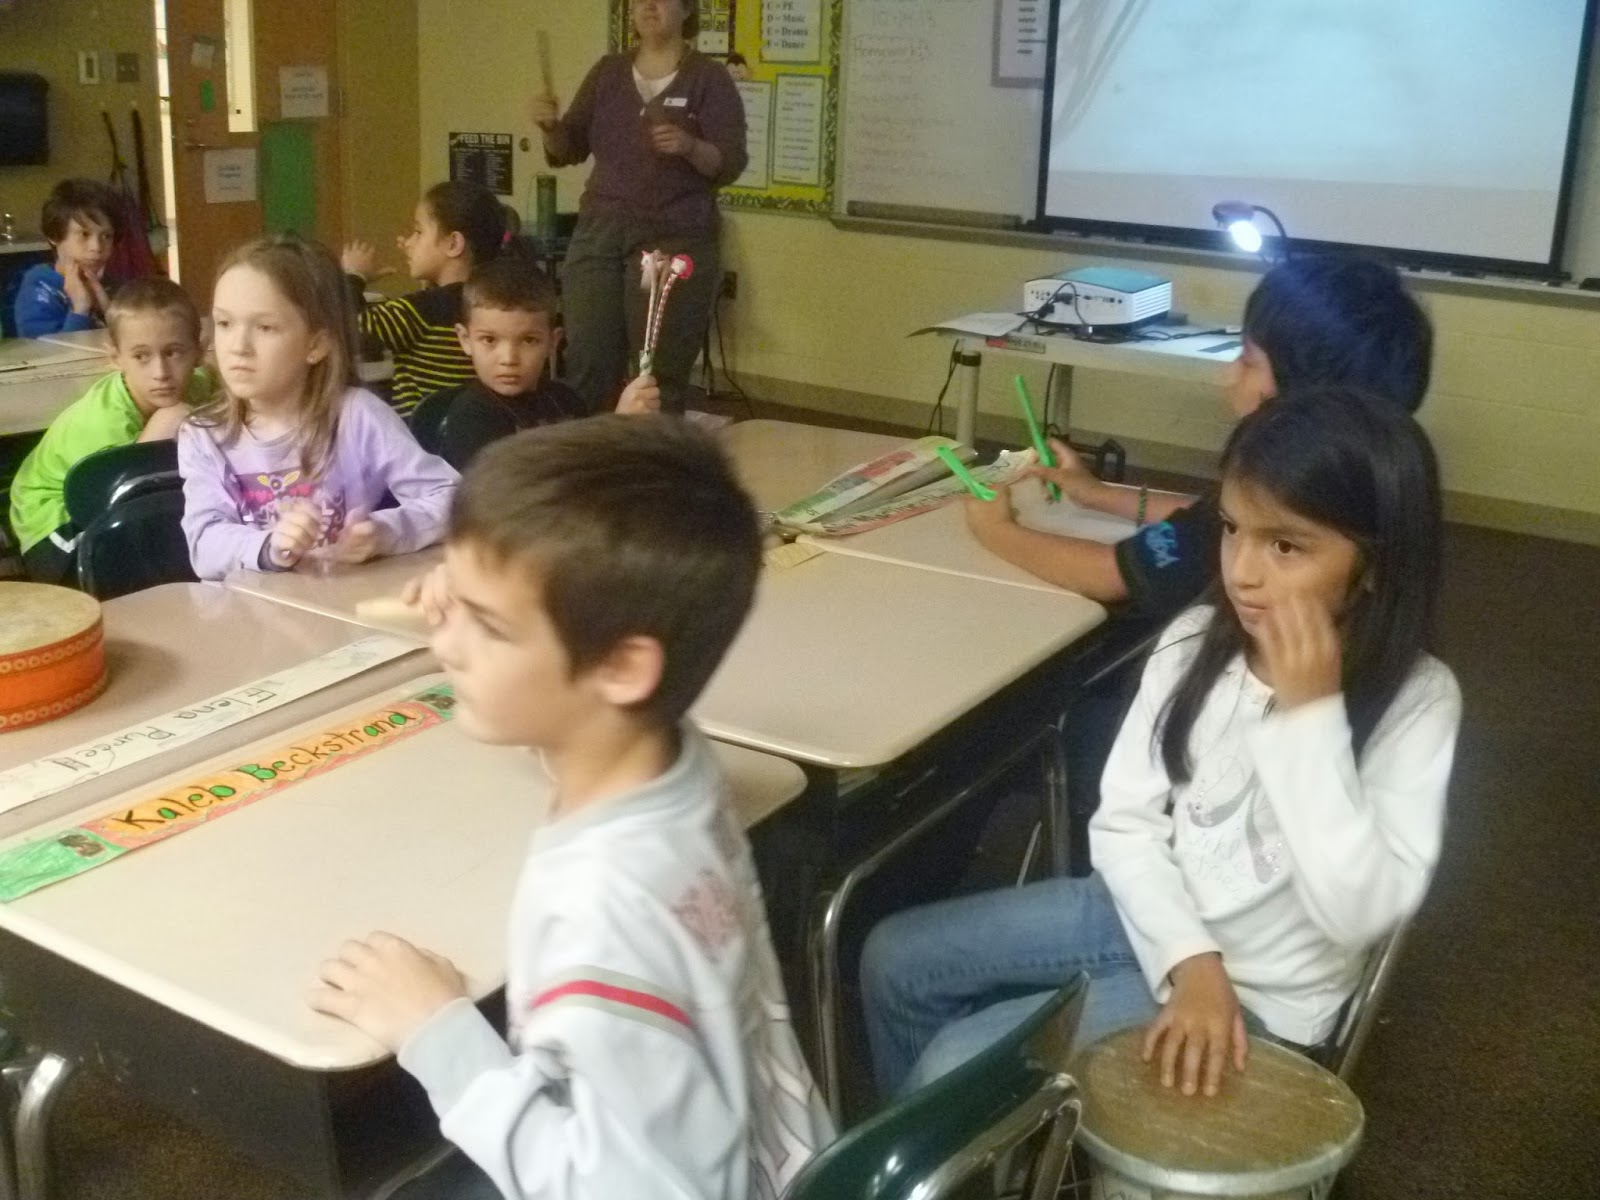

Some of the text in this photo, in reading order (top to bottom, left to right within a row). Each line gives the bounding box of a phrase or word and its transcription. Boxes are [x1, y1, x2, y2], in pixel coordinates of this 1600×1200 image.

[783, 13, 806, 22] Music
[781, 26, 808, 36] Drama
[781, 40, 806, 49] Dance
[459, 133, 479, 144] FEED
[480, 134, 495, 145] THE
[175, 686, 279, 722] Elena
[111, 708, 417, 834] Kaleb Beckstrand
